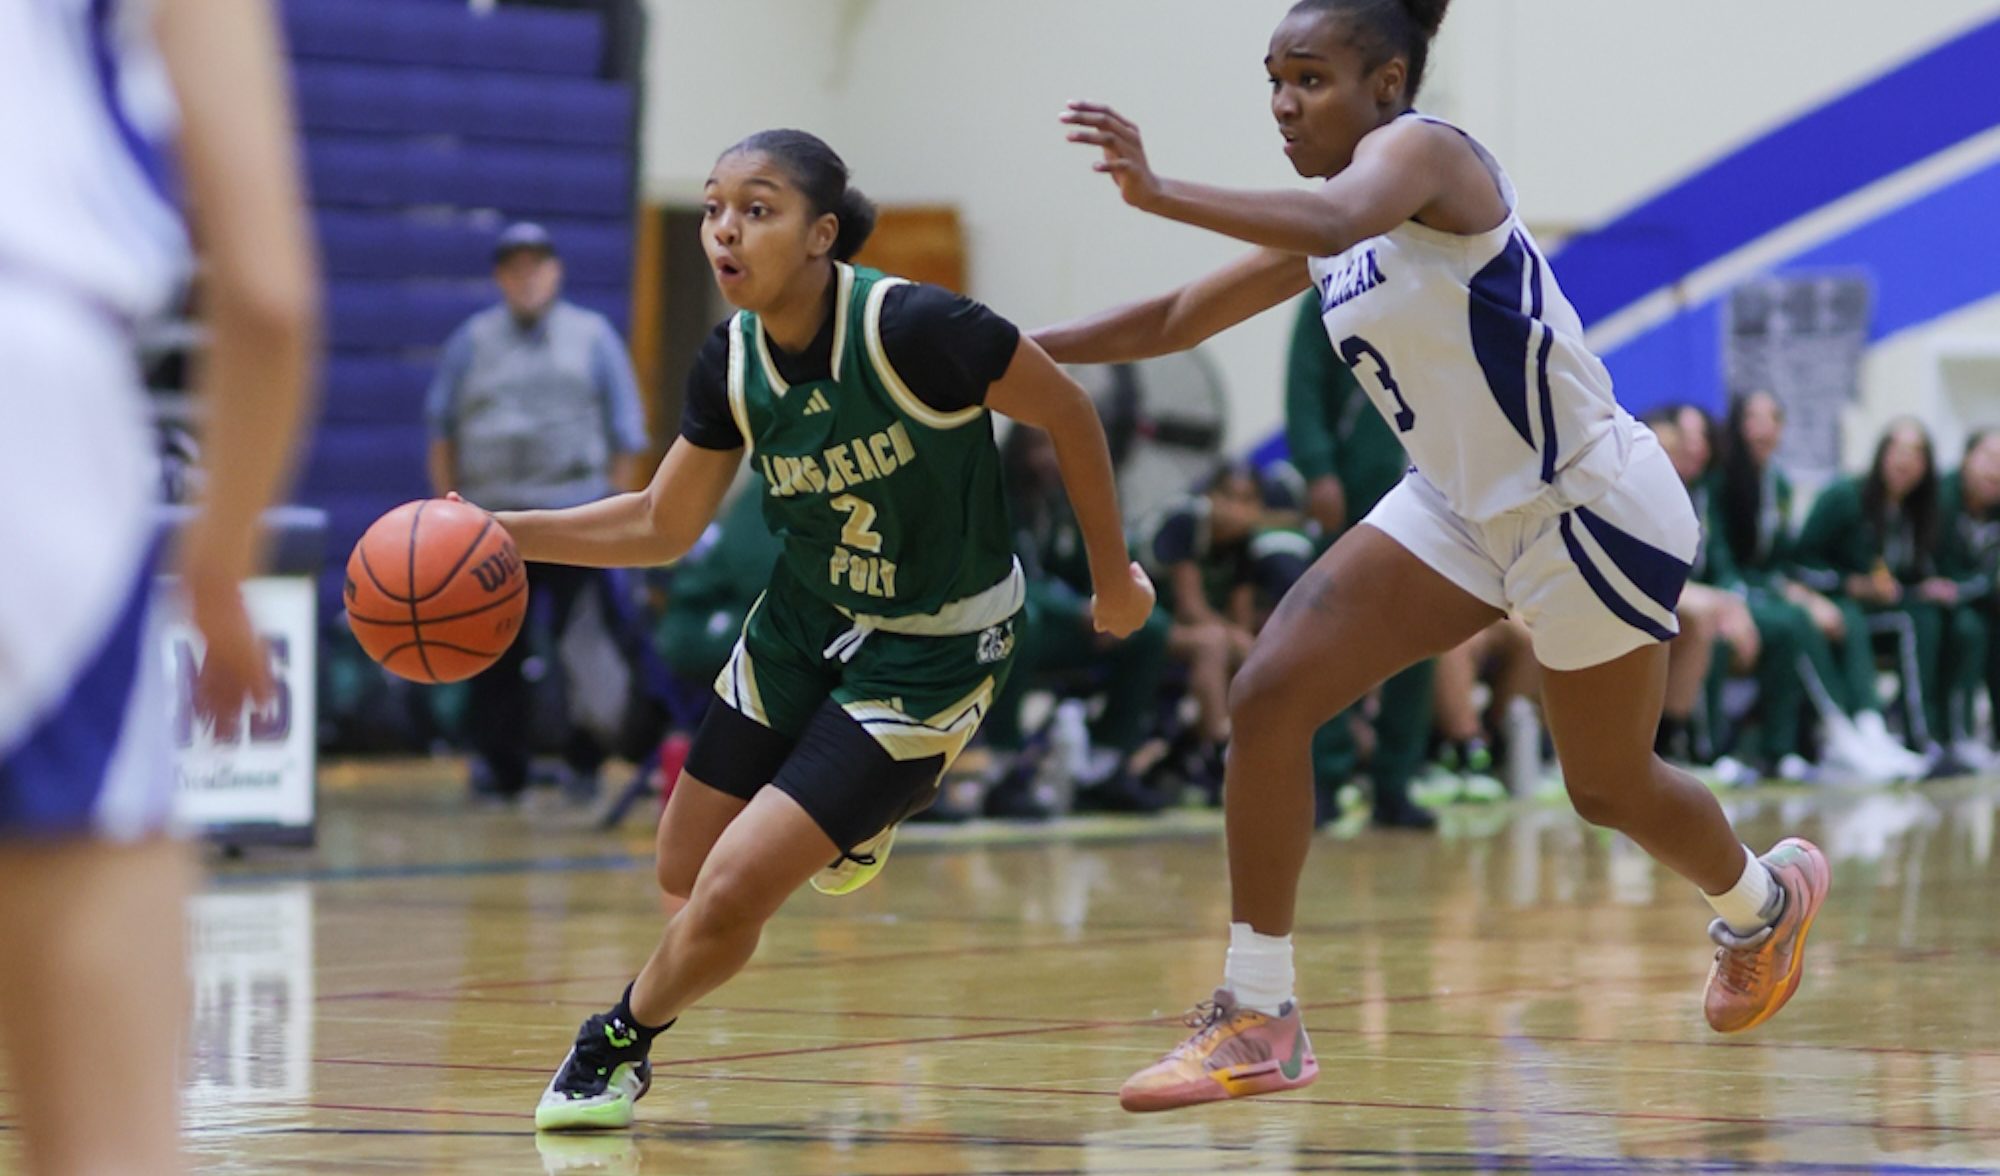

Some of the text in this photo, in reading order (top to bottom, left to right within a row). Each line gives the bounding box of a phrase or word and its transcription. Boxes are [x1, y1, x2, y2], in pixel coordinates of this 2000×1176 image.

[1340, 334, 1416, 433] 3
[829, 493, 883, 553] 2
[829, 545, 897, 598] POLY
